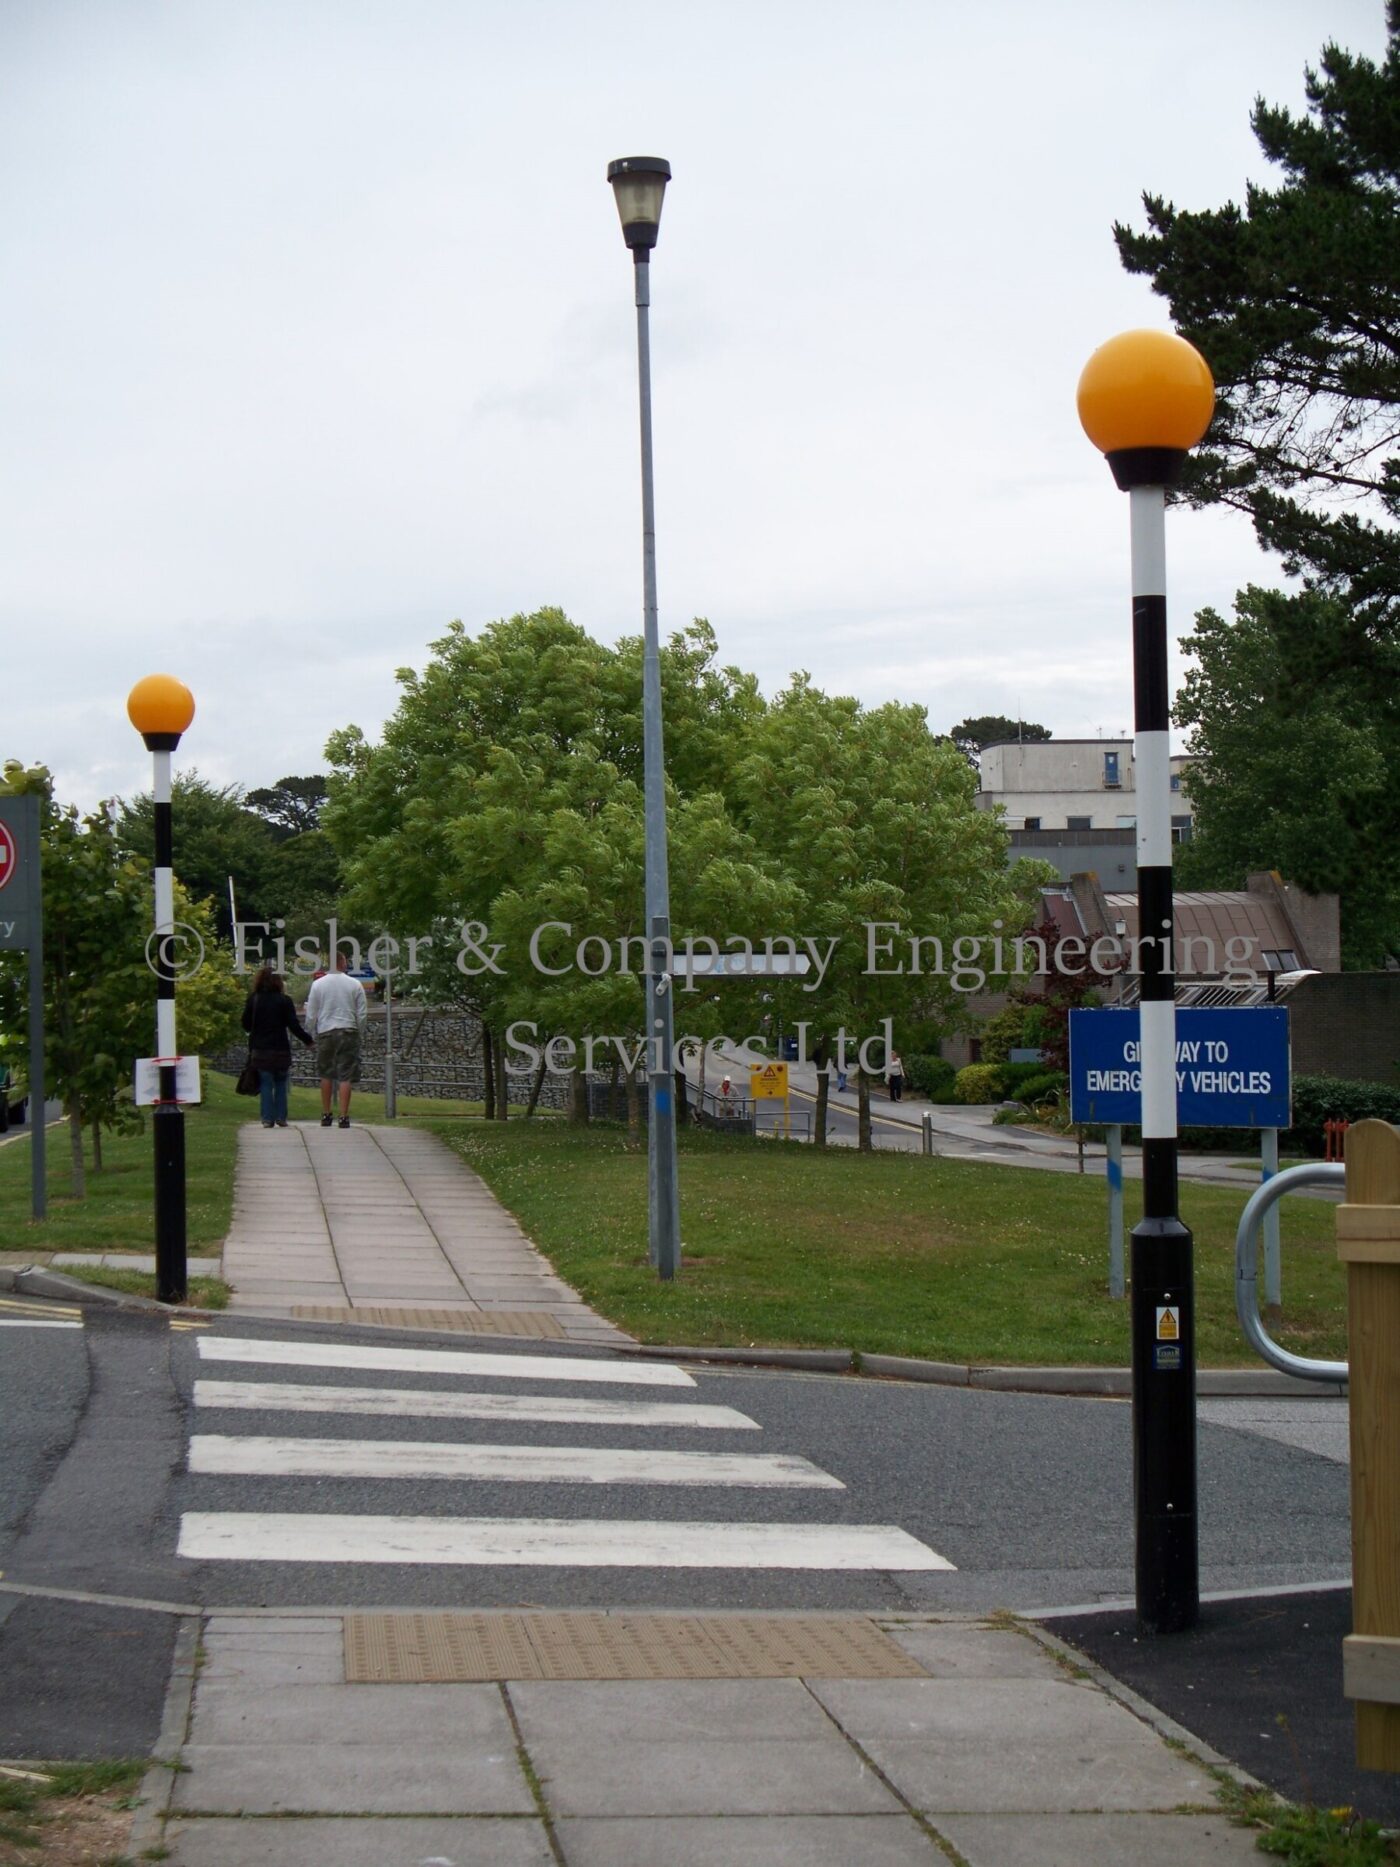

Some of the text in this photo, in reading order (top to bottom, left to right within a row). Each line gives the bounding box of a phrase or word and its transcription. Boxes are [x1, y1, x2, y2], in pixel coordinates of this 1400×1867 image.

[1204, 1041, 1229, 1063] TO
[1087, 1070, 1271, 1094] EMERGY VEHICLES
